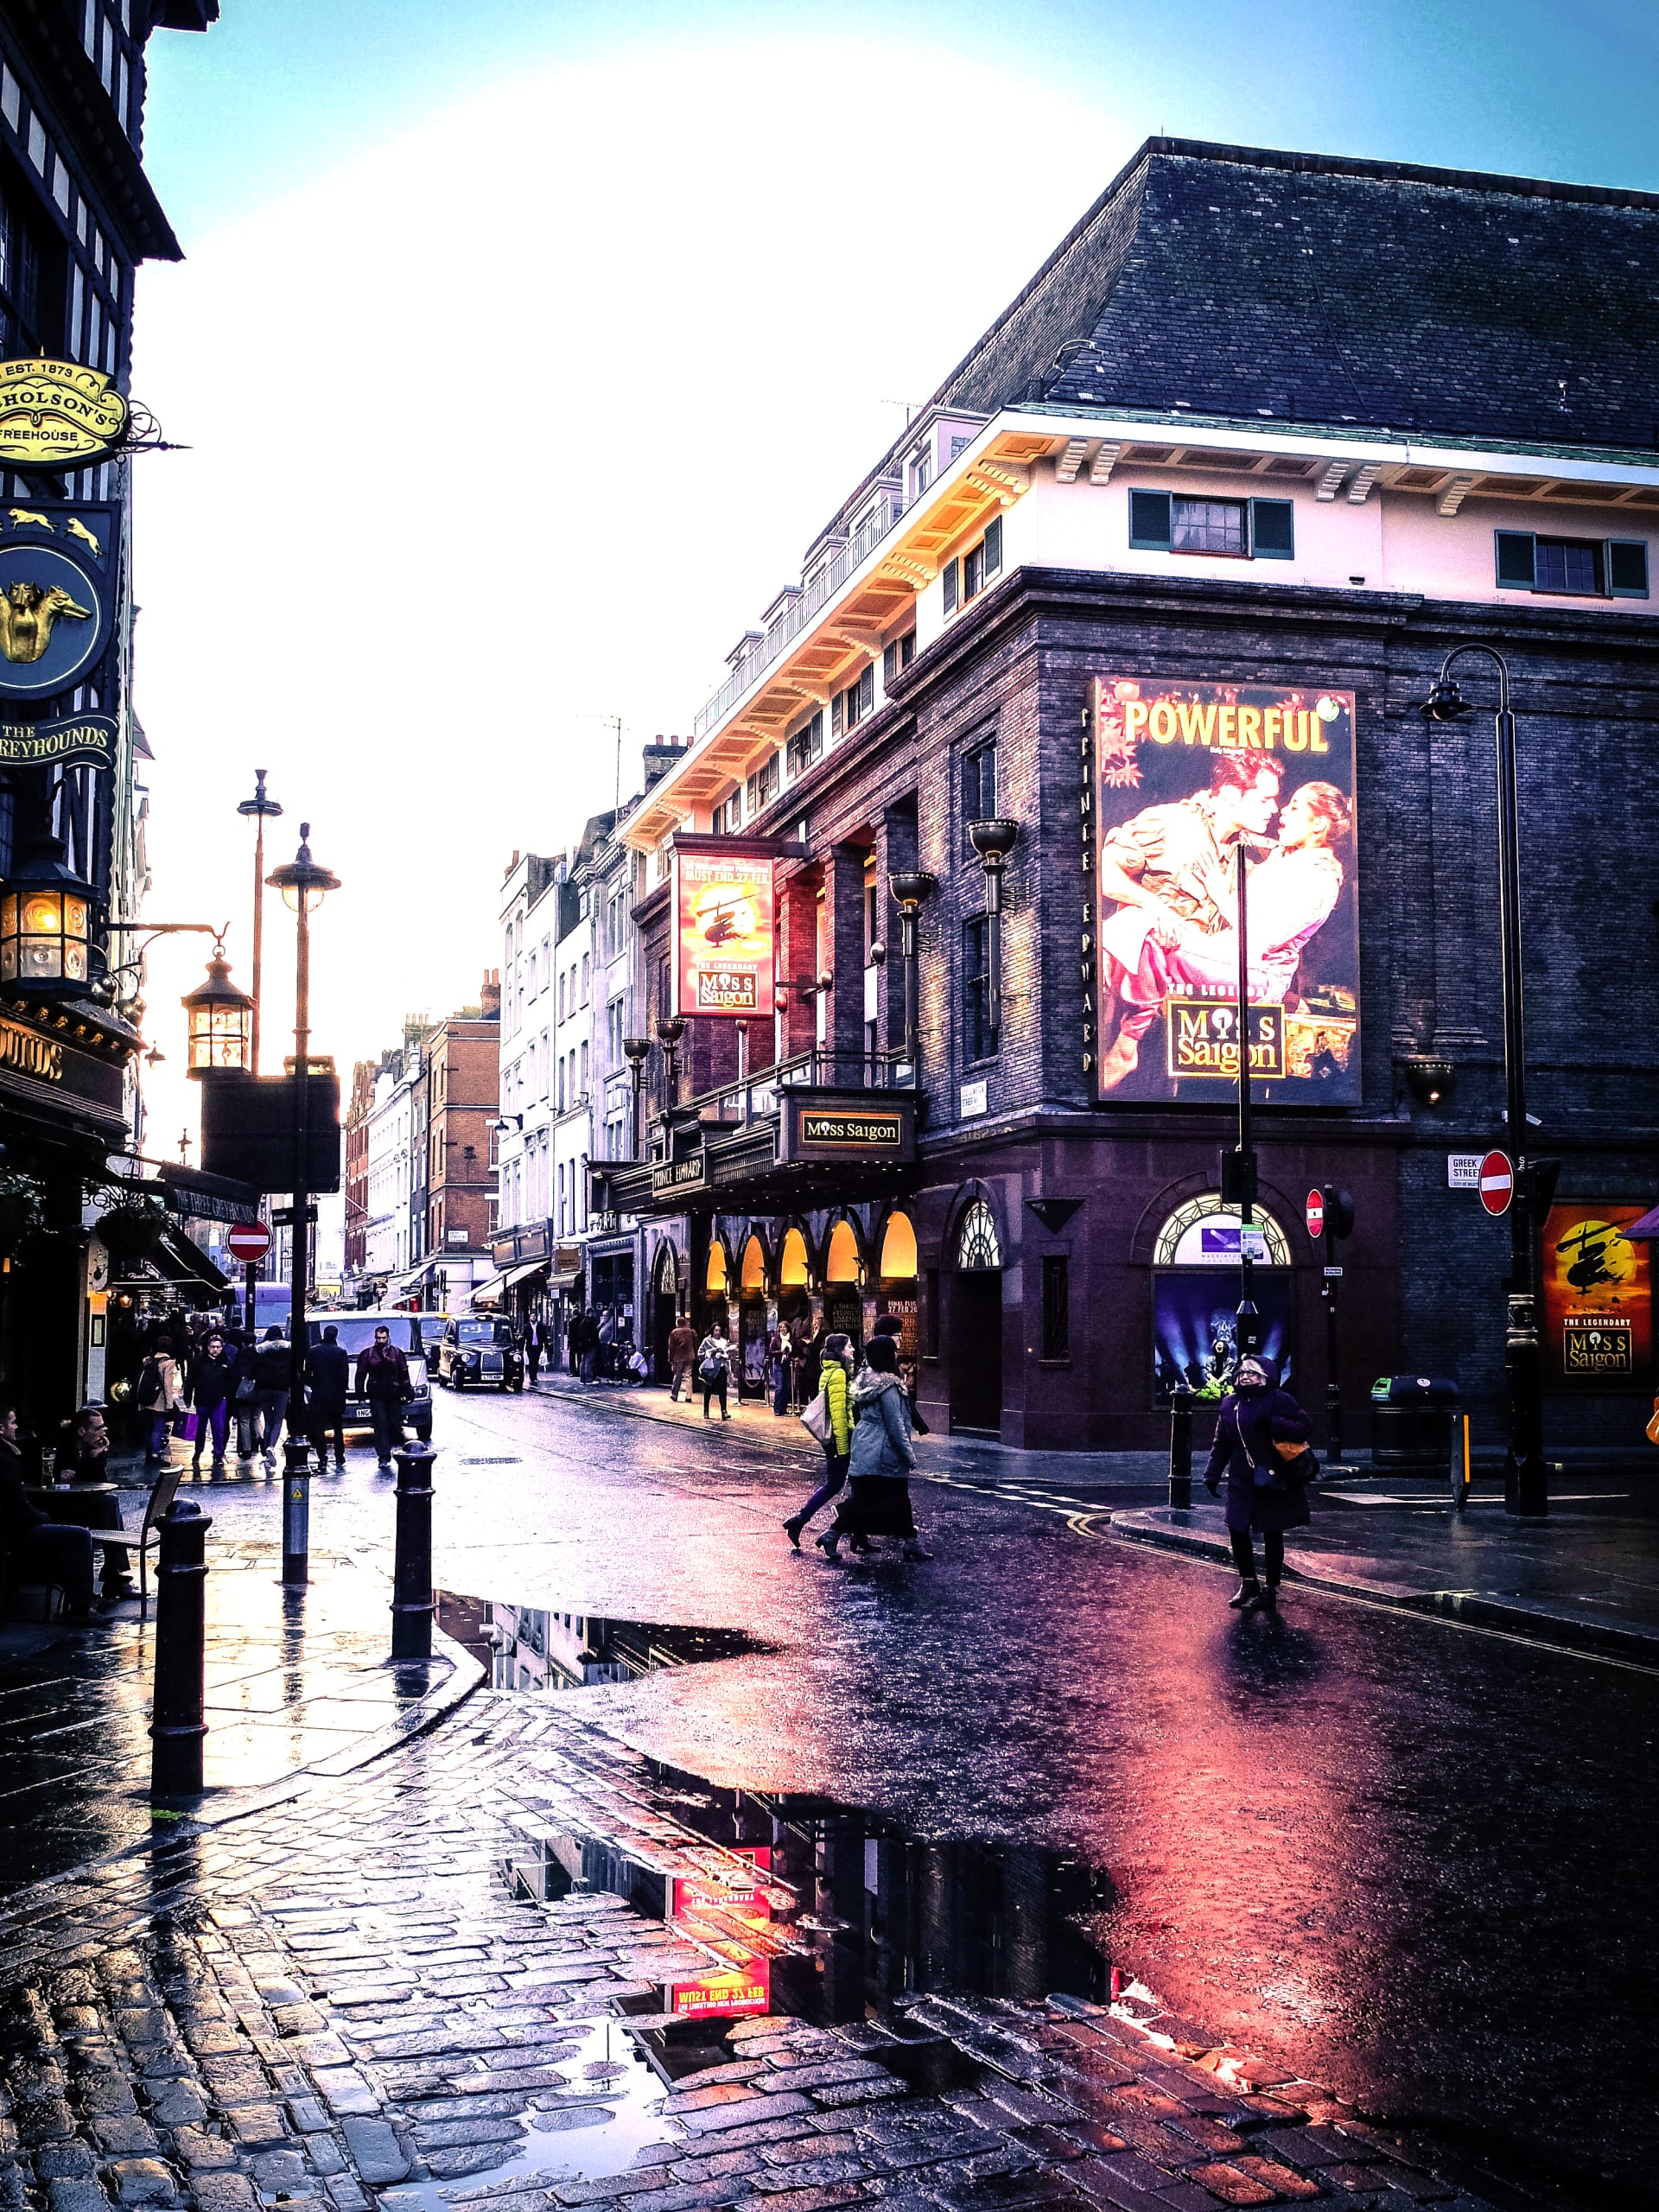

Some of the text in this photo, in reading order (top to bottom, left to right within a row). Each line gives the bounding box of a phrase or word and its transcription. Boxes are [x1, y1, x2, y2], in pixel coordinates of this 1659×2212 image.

[5, 363, 73, 378] EST. 1873
[0, 391, 108, 425] HOLSON'S
[0, 429, 79, 442] REEHOUSE
[3, 726, 35, 738] THE
[1123, 700, 1329, 753] POWERFUL
[701, 973, 753, 992] Miss
[701, 986, 754, 1007] Saigon
[806, 1122, 896, 1141] Miss Saigon
[1452, 1159, 1478, 1168] GREEK
[1569, 1332, 1626, 1351] Miss
[1569, 1350, 1626, 1371] Saigon
